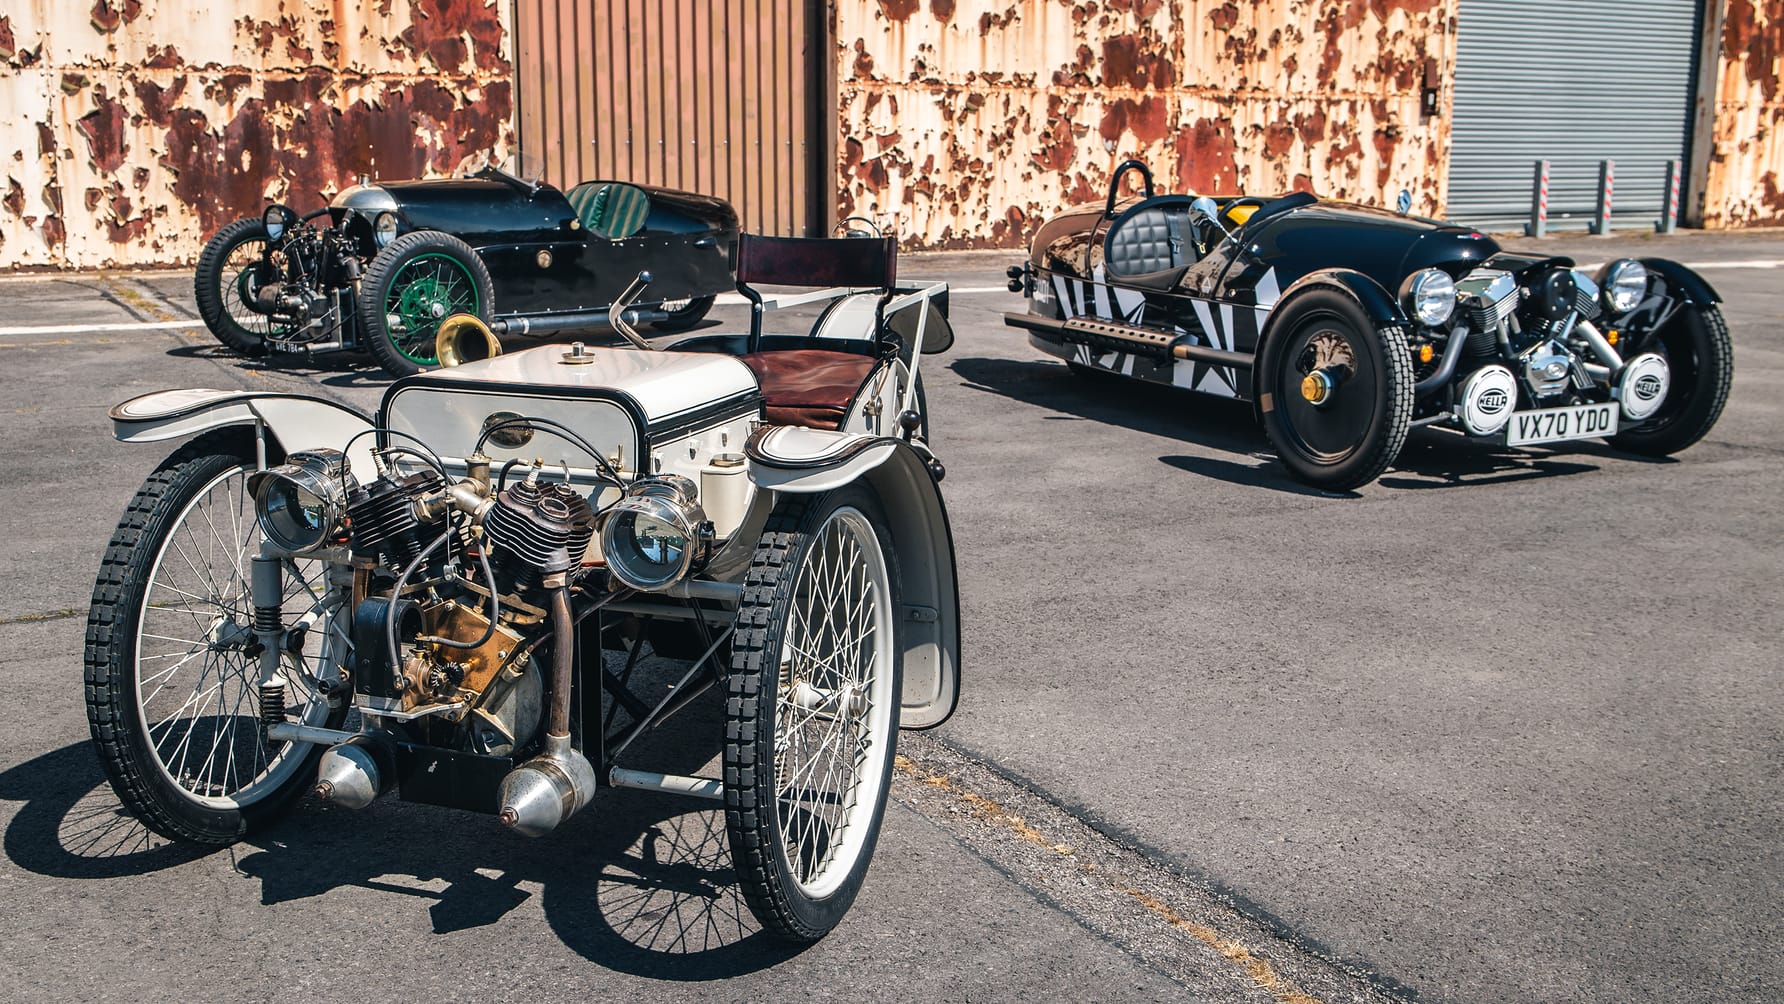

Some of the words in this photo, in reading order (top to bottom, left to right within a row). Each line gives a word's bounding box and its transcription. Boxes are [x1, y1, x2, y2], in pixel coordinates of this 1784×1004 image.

[1637, 381, 1661, 395] HELLA
[1479, 395, 1508, 407] HELLA
[1519, 412, 1567, 439] VX70
[1575, 408, 1609, 433] YDO
